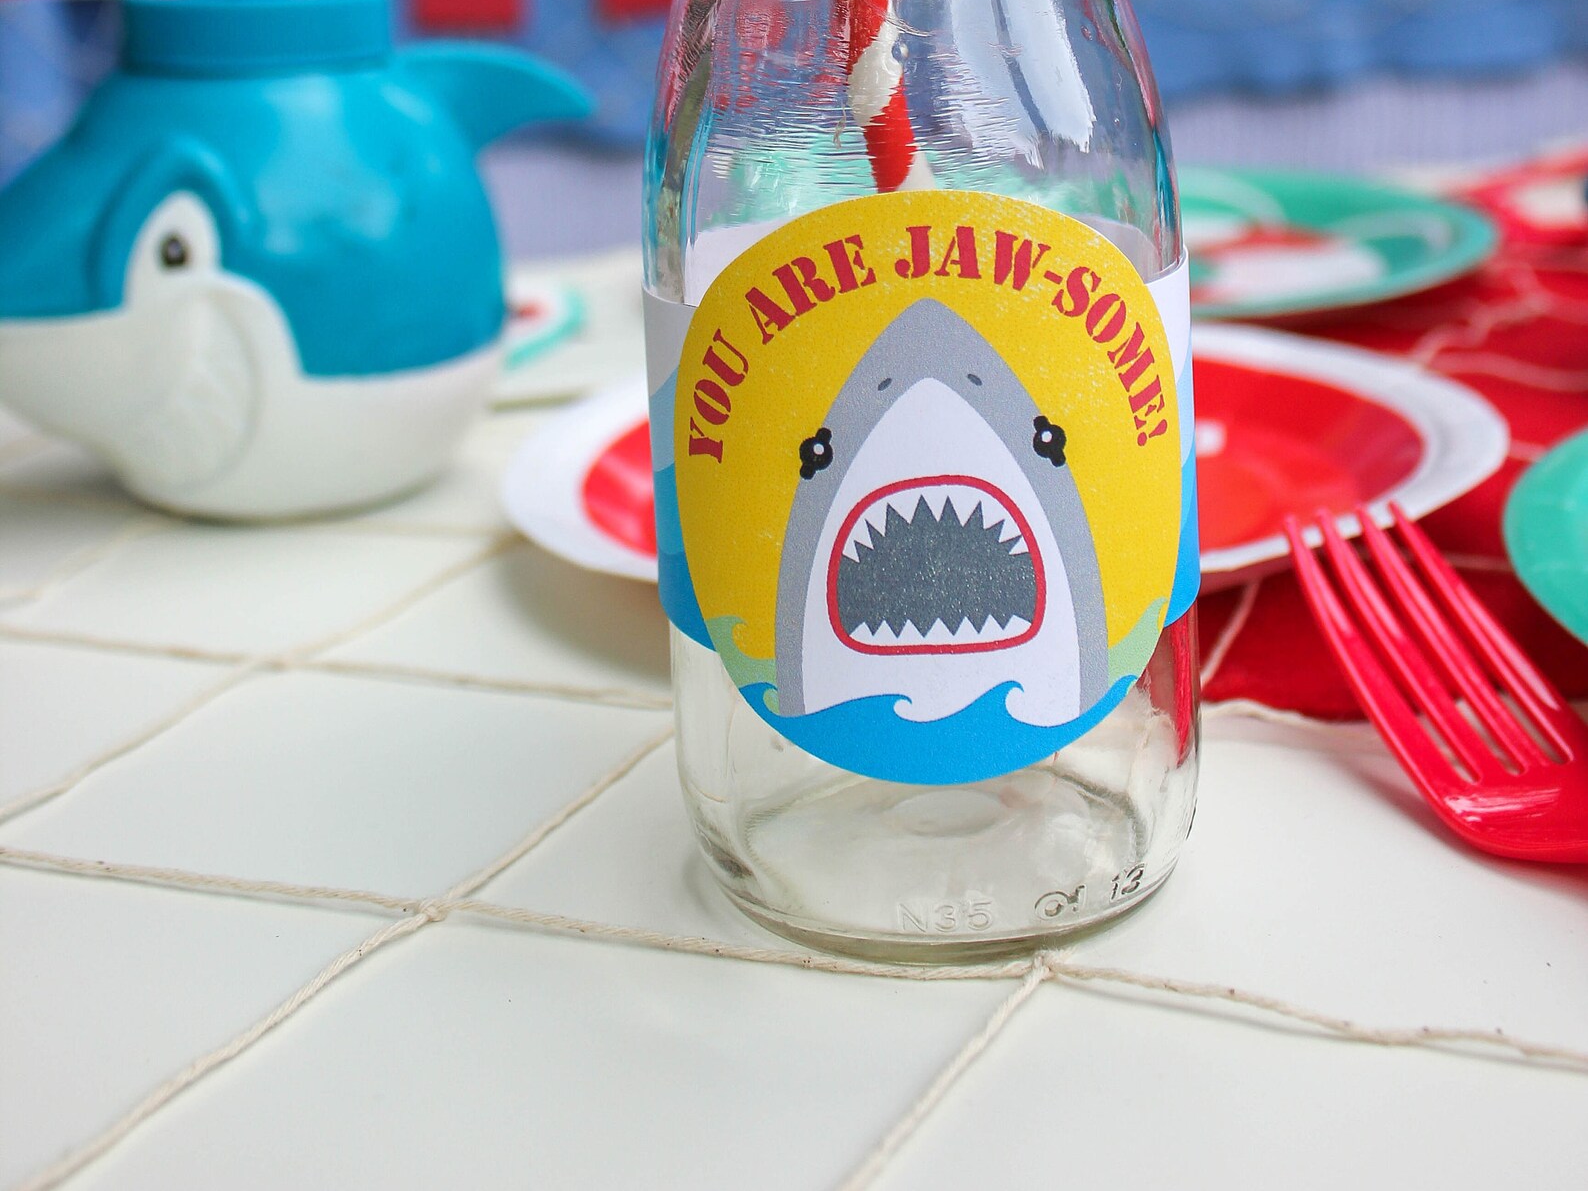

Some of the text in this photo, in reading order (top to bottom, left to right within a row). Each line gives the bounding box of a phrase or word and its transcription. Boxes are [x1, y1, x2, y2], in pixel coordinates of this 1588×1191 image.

[688, 225, 1169, 464] YOU ARE JAW-SOME!
[896, 897, 995, 934] N35
